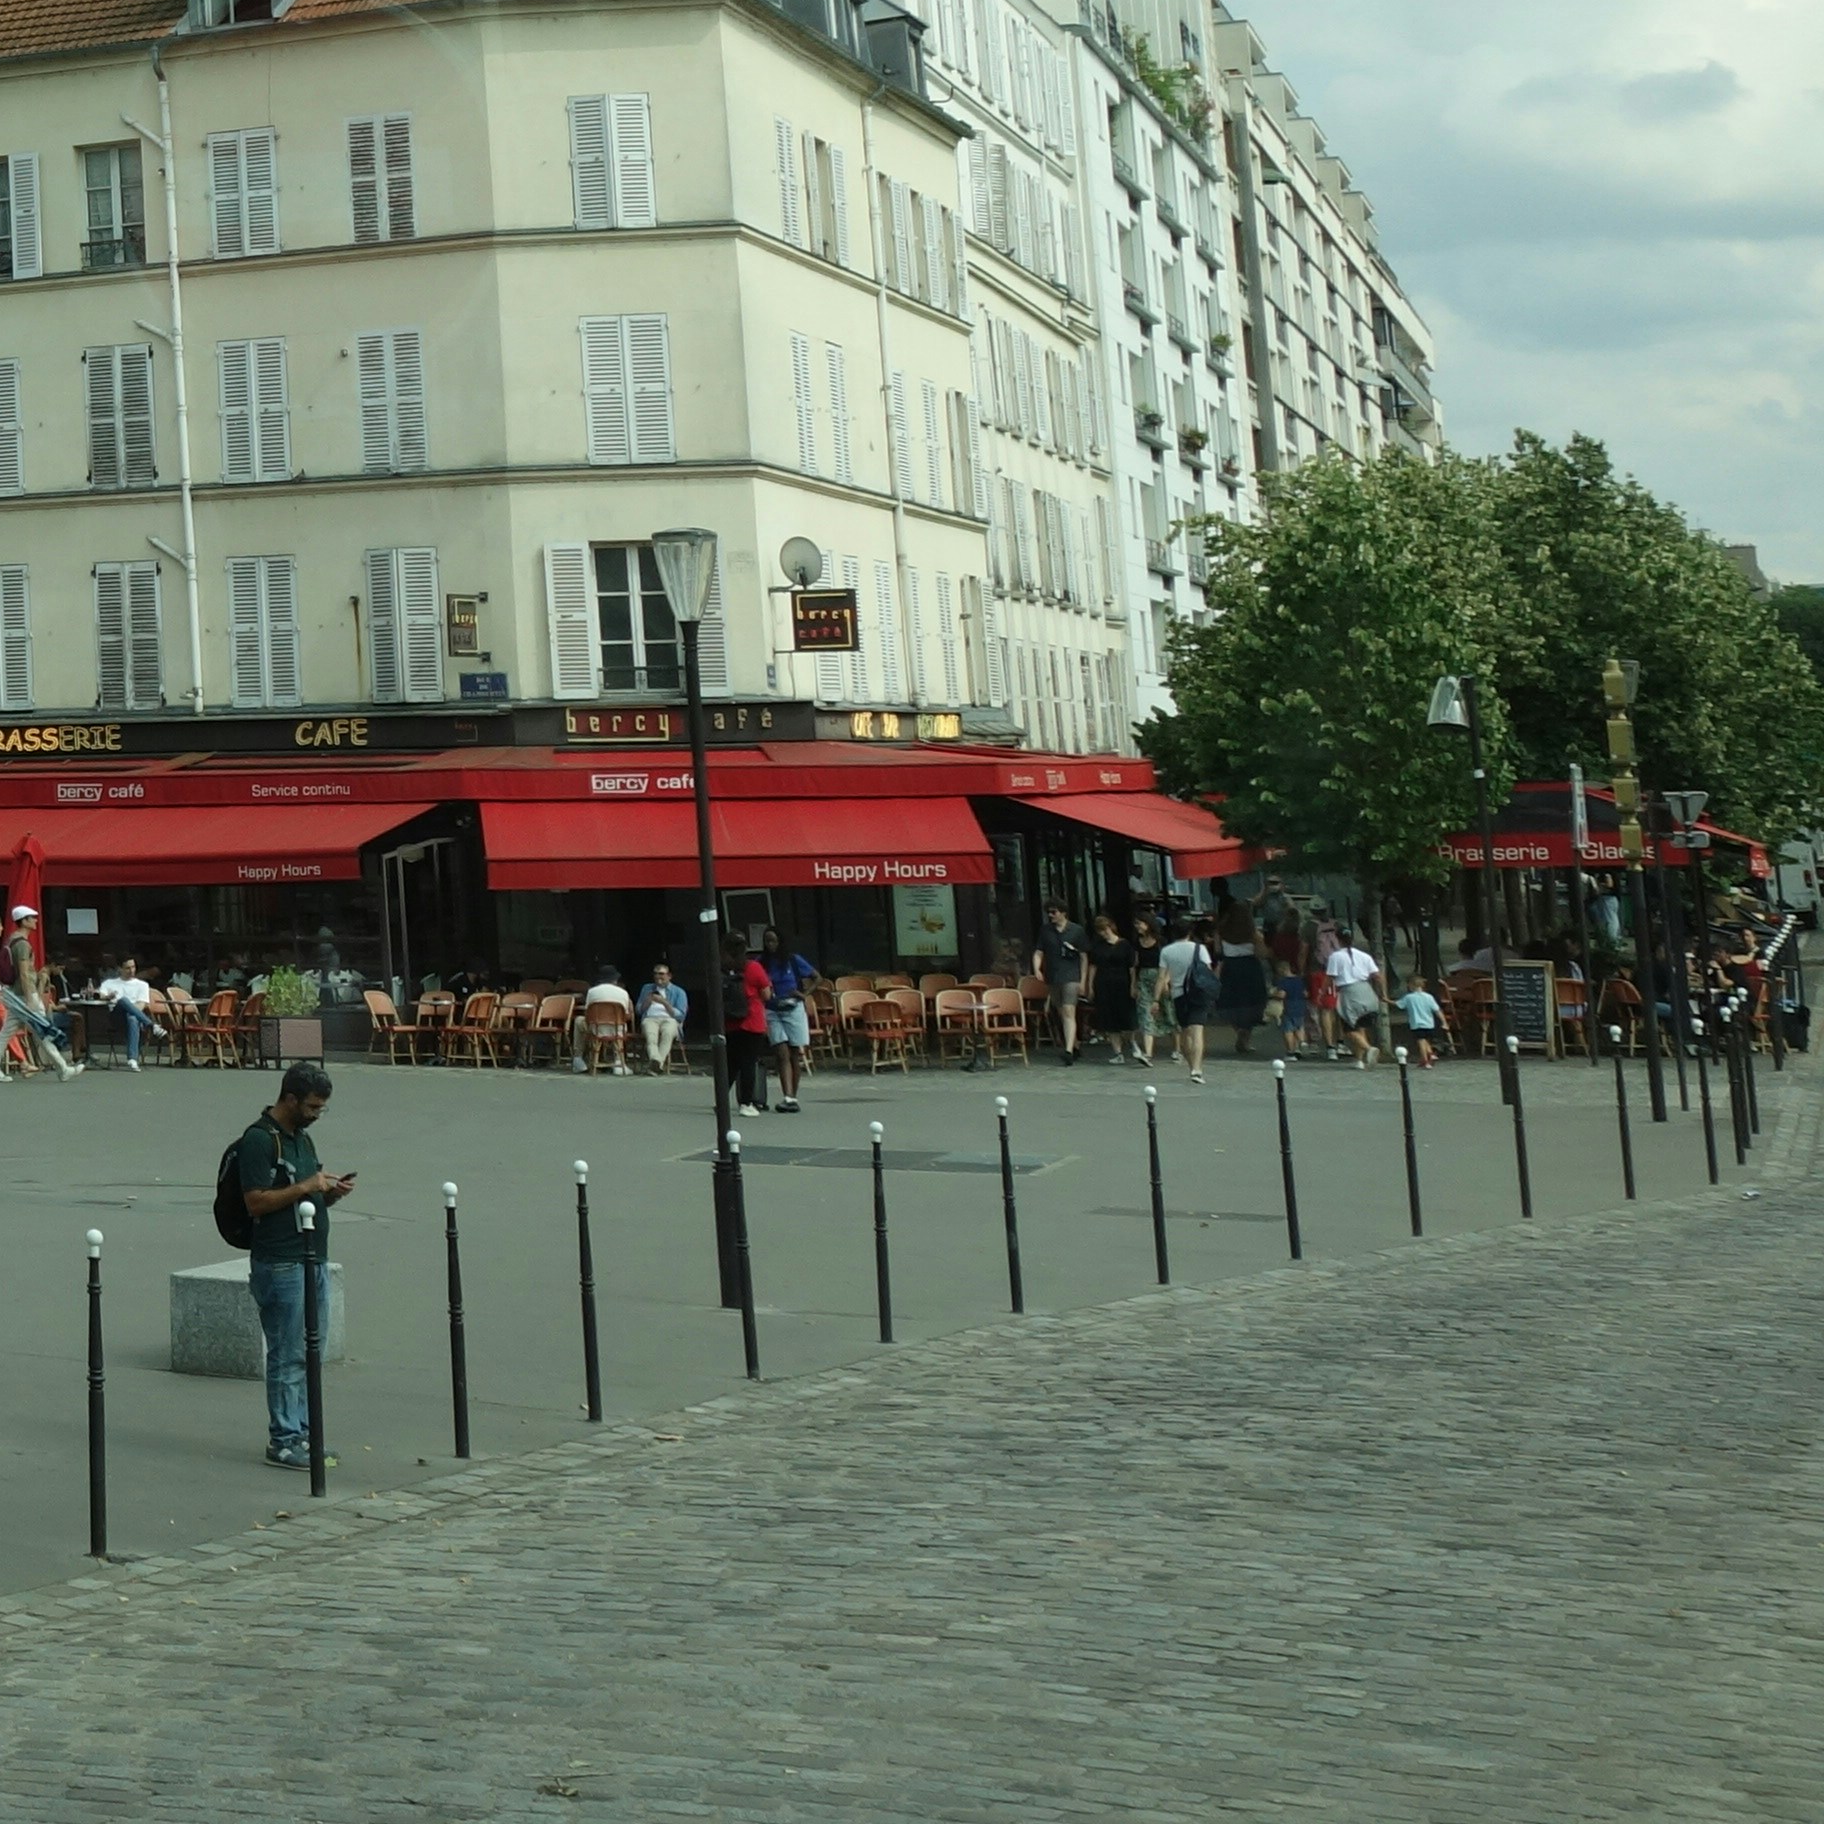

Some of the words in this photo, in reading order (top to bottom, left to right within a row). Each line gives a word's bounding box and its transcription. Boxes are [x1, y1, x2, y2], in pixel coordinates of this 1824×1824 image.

[295, 718, 369, 747] CAFE
[566, 707, 669, 741] bercy
[713, 707, 773, 730] afé
[57, 783, 103, 802] bercy
[108, 783, 145, 798] café
[251, 784, 298, 797] Service
[302, 783, 351, 796] continu
[591, 773, 649, 794] bercy
[237, 864, 278, 881] Happy
[281, 863, 322, 878] Hours
[814, 860, 878, 883] Happy
[883, 859, 947, 879] Hours
